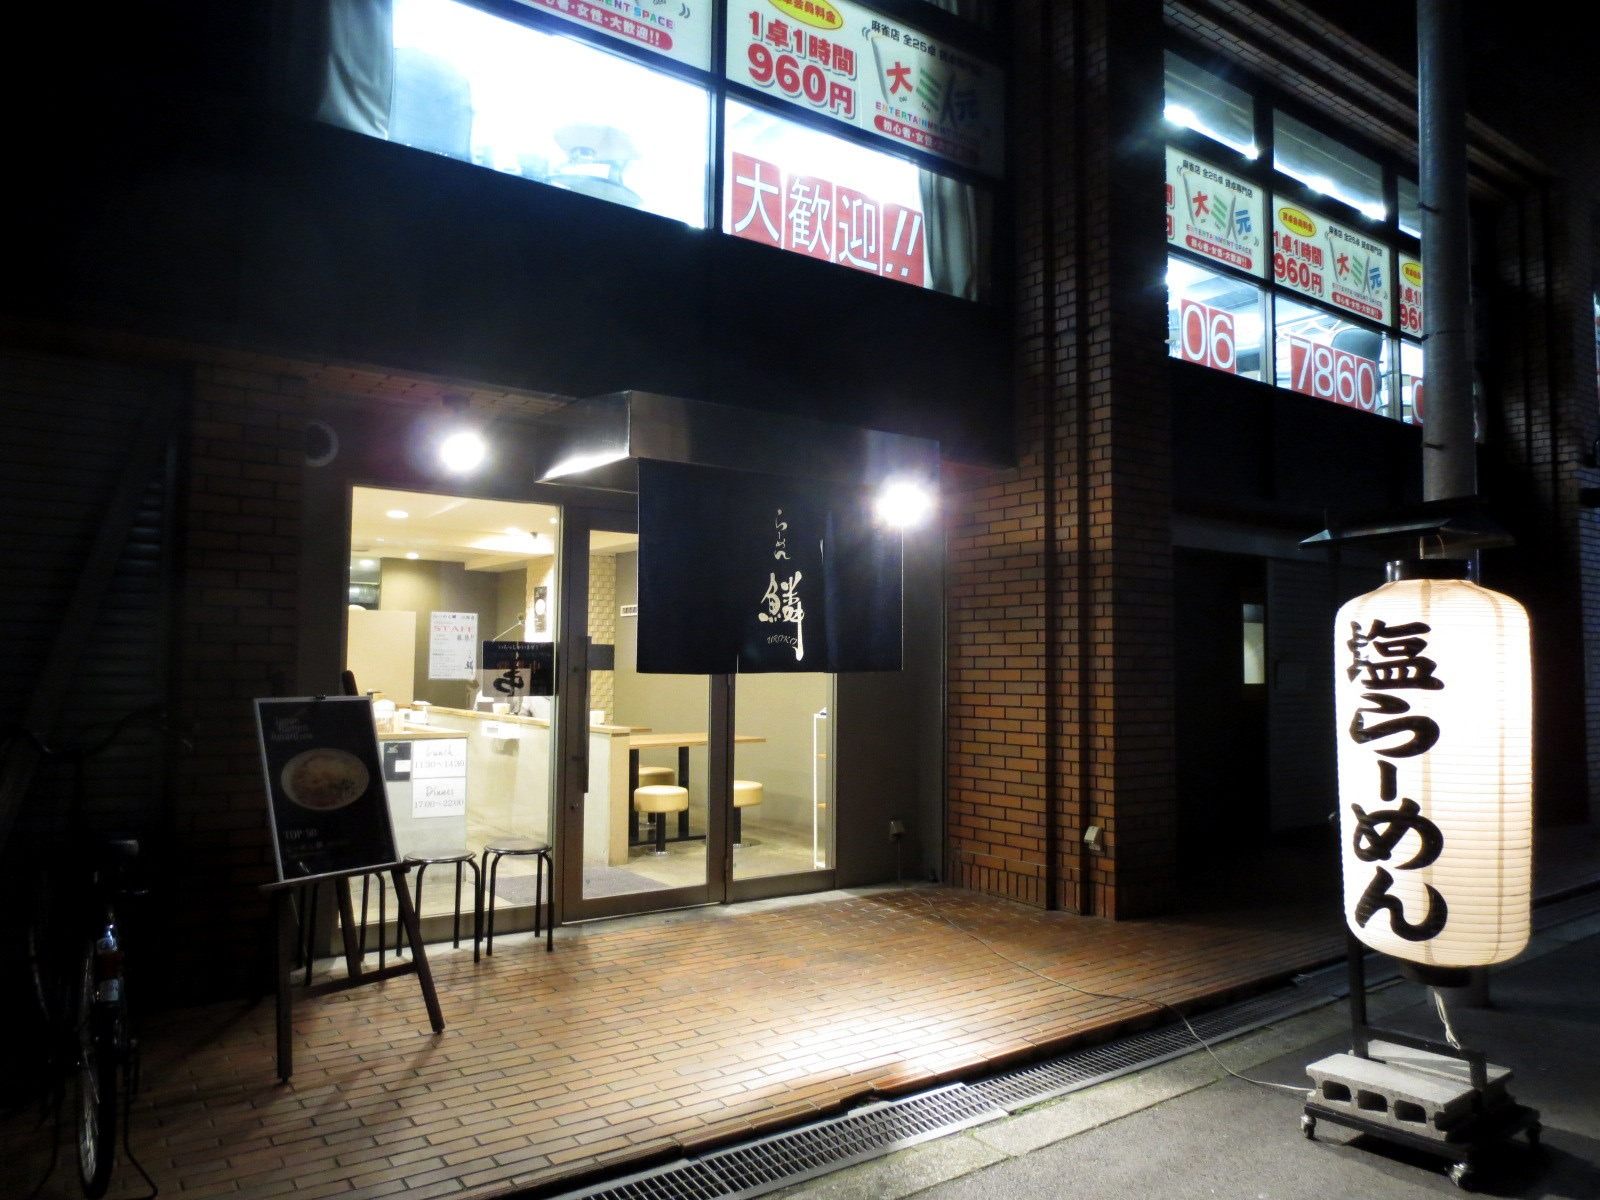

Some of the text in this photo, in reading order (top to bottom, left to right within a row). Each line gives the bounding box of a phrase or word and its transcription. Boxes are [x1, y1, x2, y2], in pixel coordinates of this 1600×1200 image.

[634, 7, 674, 29] SPACE
[749, 12, 855, 77] 1卓1時間
[872, 20, 937, 57] 麻雀店 全25卓
[748, 43, 854, 116] 960円
[735, 163, 922, 277] 大歓迎!!
[1273, 230, 1322, 267] 1卓1時間
[1274, 252, 1323, 294] 960円
[1182, 304, 1234, 369] 06
[1290, 338, 1376, 410] 7860
[774, 509, 791, 560] らーめん
[1346, 618, 1449, 943] 塩らーめん
